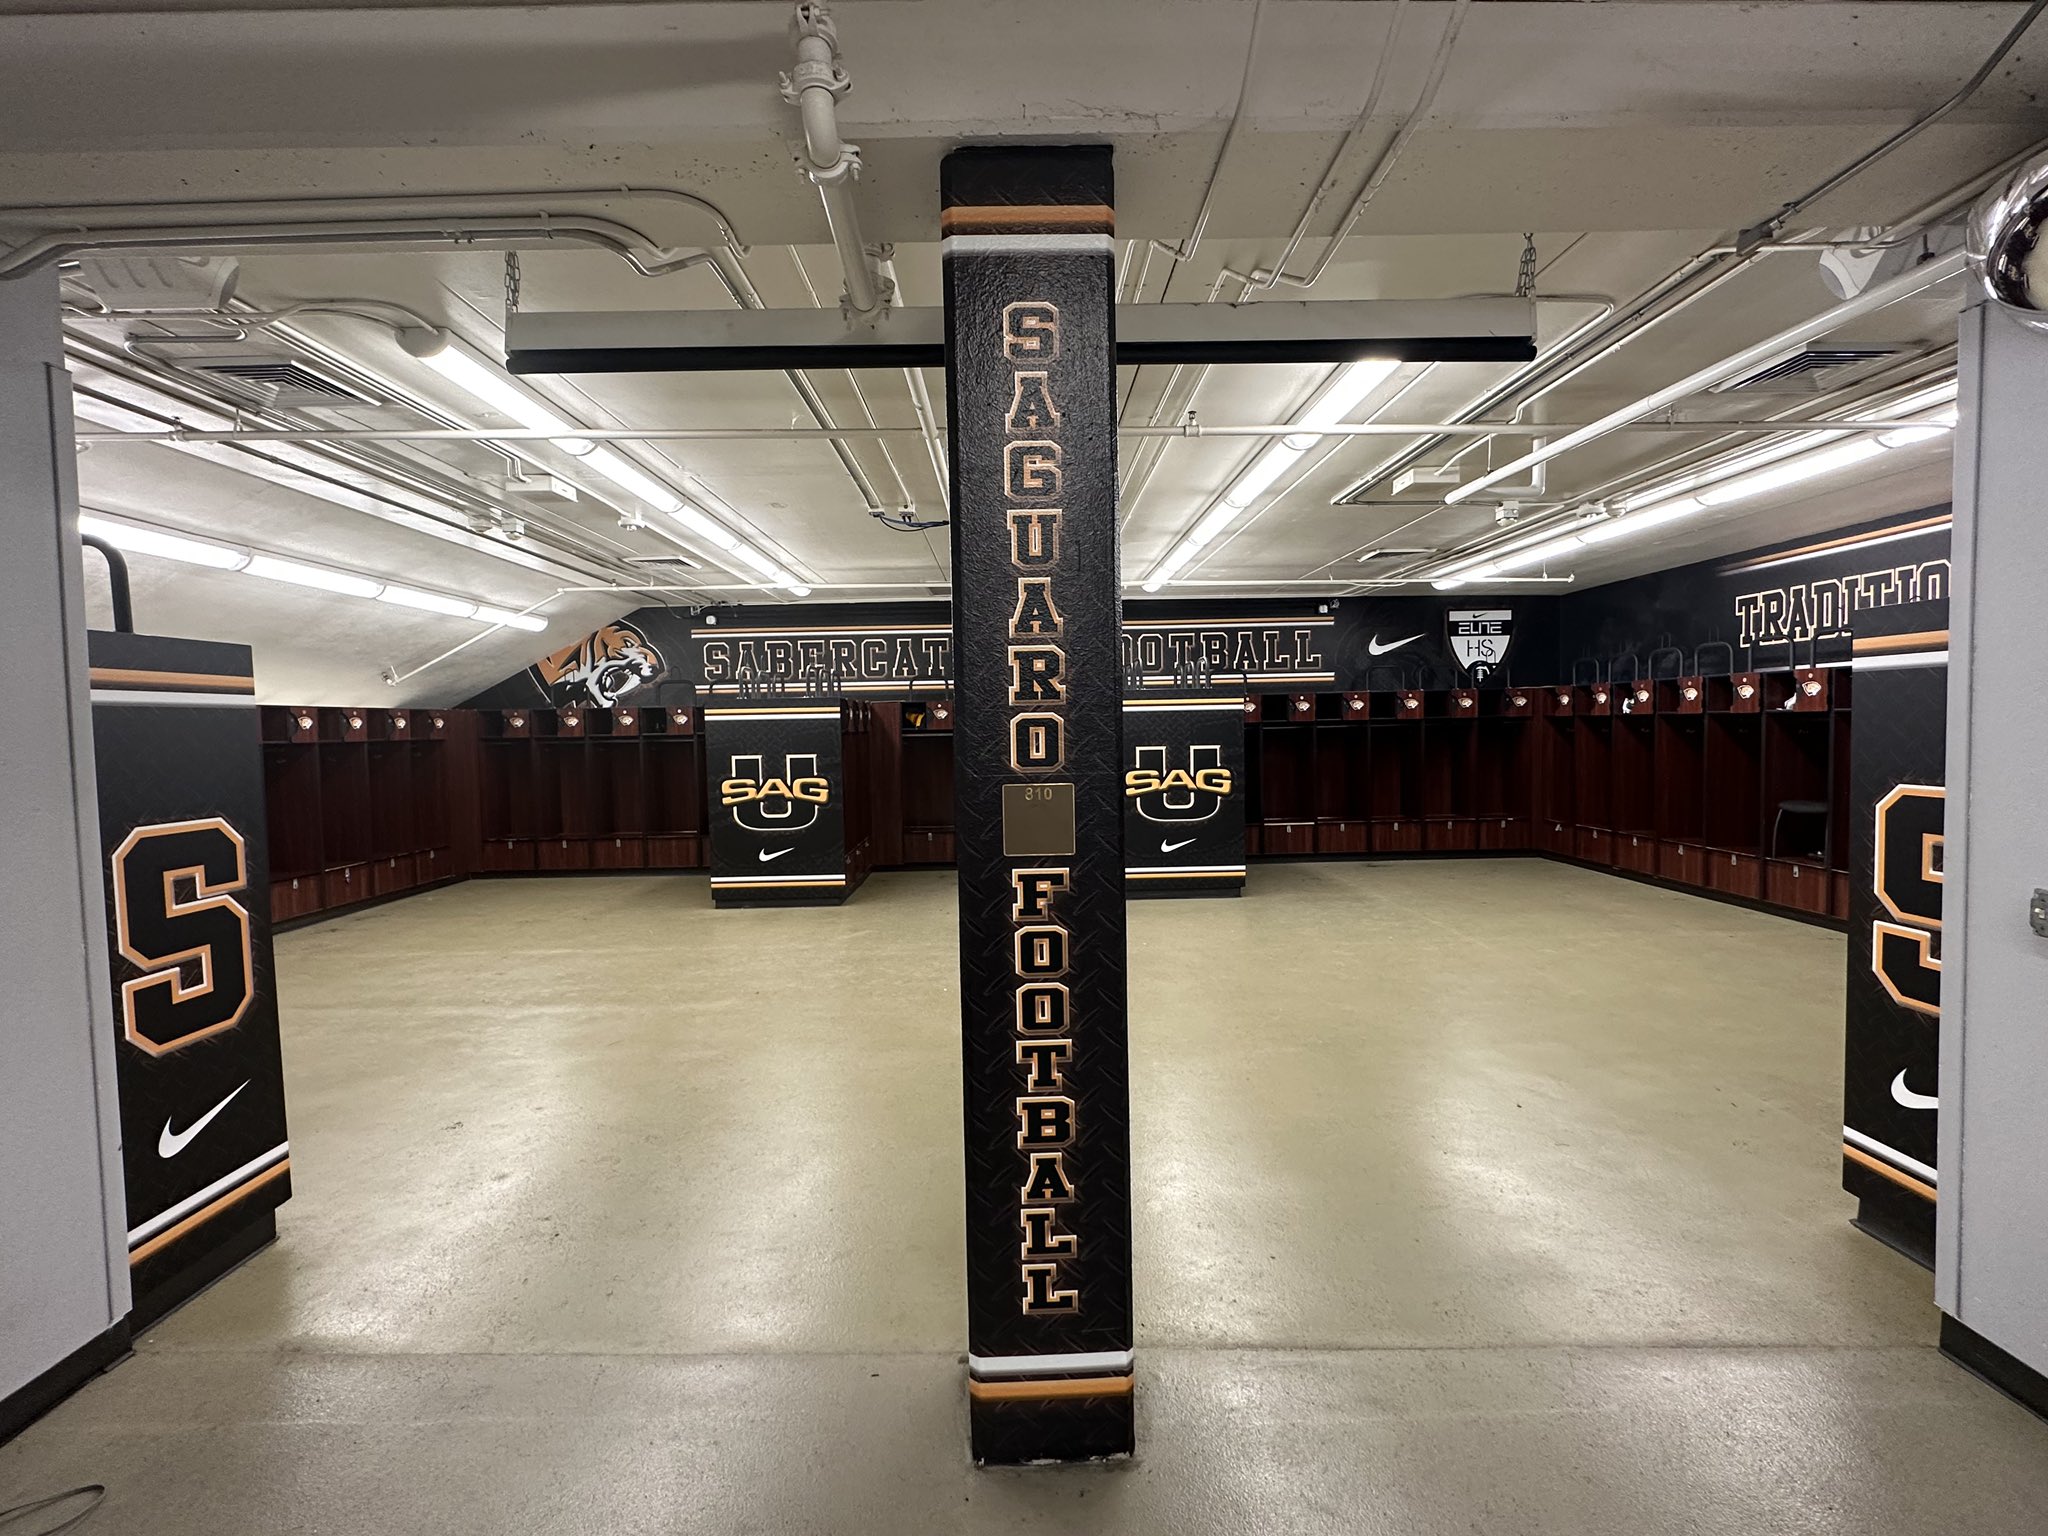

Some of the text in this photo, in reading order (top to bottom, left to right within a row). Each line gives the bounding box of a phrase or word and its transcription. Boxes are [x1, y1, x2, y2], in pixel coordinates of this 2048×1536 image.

[1003, 301, 1066, 772] SAGUARO
[1458, 621, 1502, 635] ELITE
[1466, 639, 1494, 657] HS
[720, 777, 830, 806] SAG
[1125, 768, 1232, 797] SAG
[111, 816, 255, 1058] S
[1011, 867, 1079, 1316] FOOTBALL
